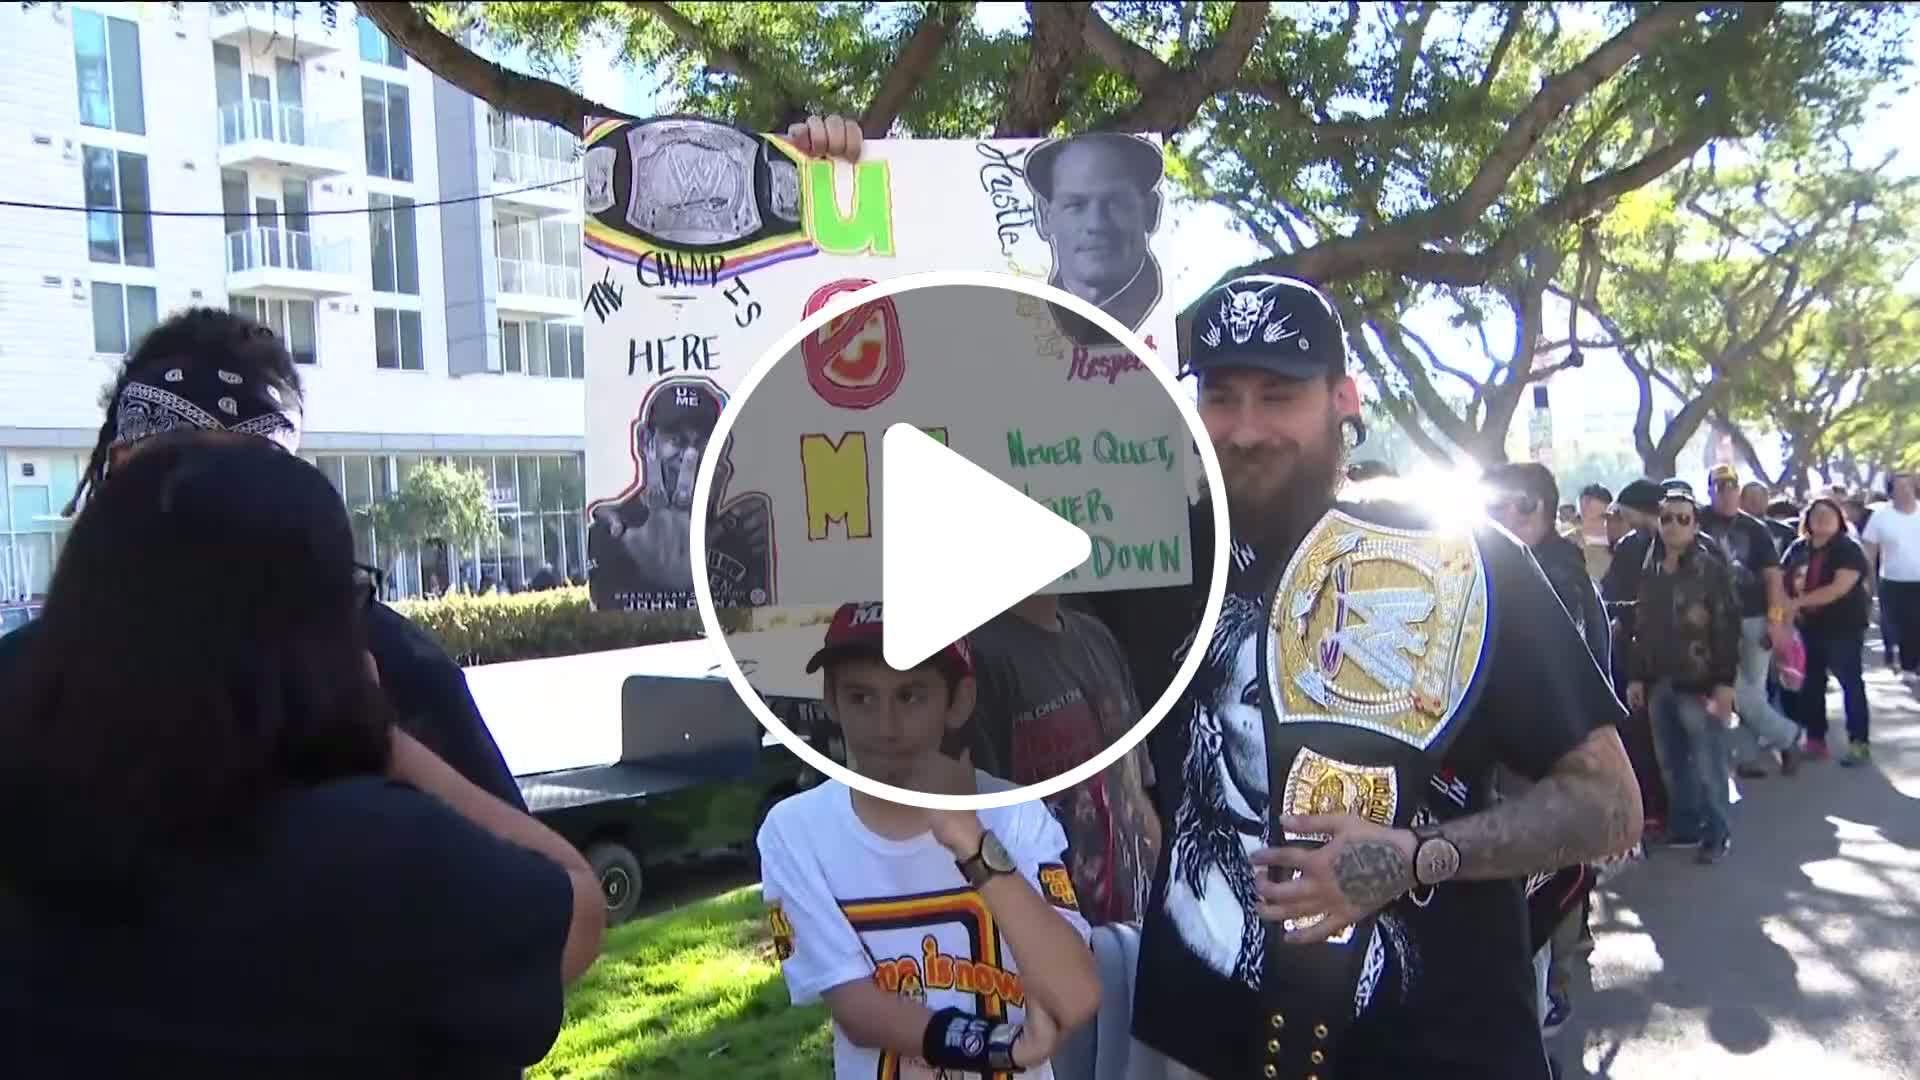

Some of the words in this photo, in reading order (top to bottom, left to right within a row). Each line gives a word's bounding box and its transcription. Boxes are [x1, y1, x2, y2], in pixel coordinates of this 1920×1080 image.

[583, 265, 625, 323] THE
[636, 249, 725, 288] CHAMP
[627, 333, 721, 376] HERE
[624, 599, 676, 610] JOHN
[687, 599, 737, 610] CNA
